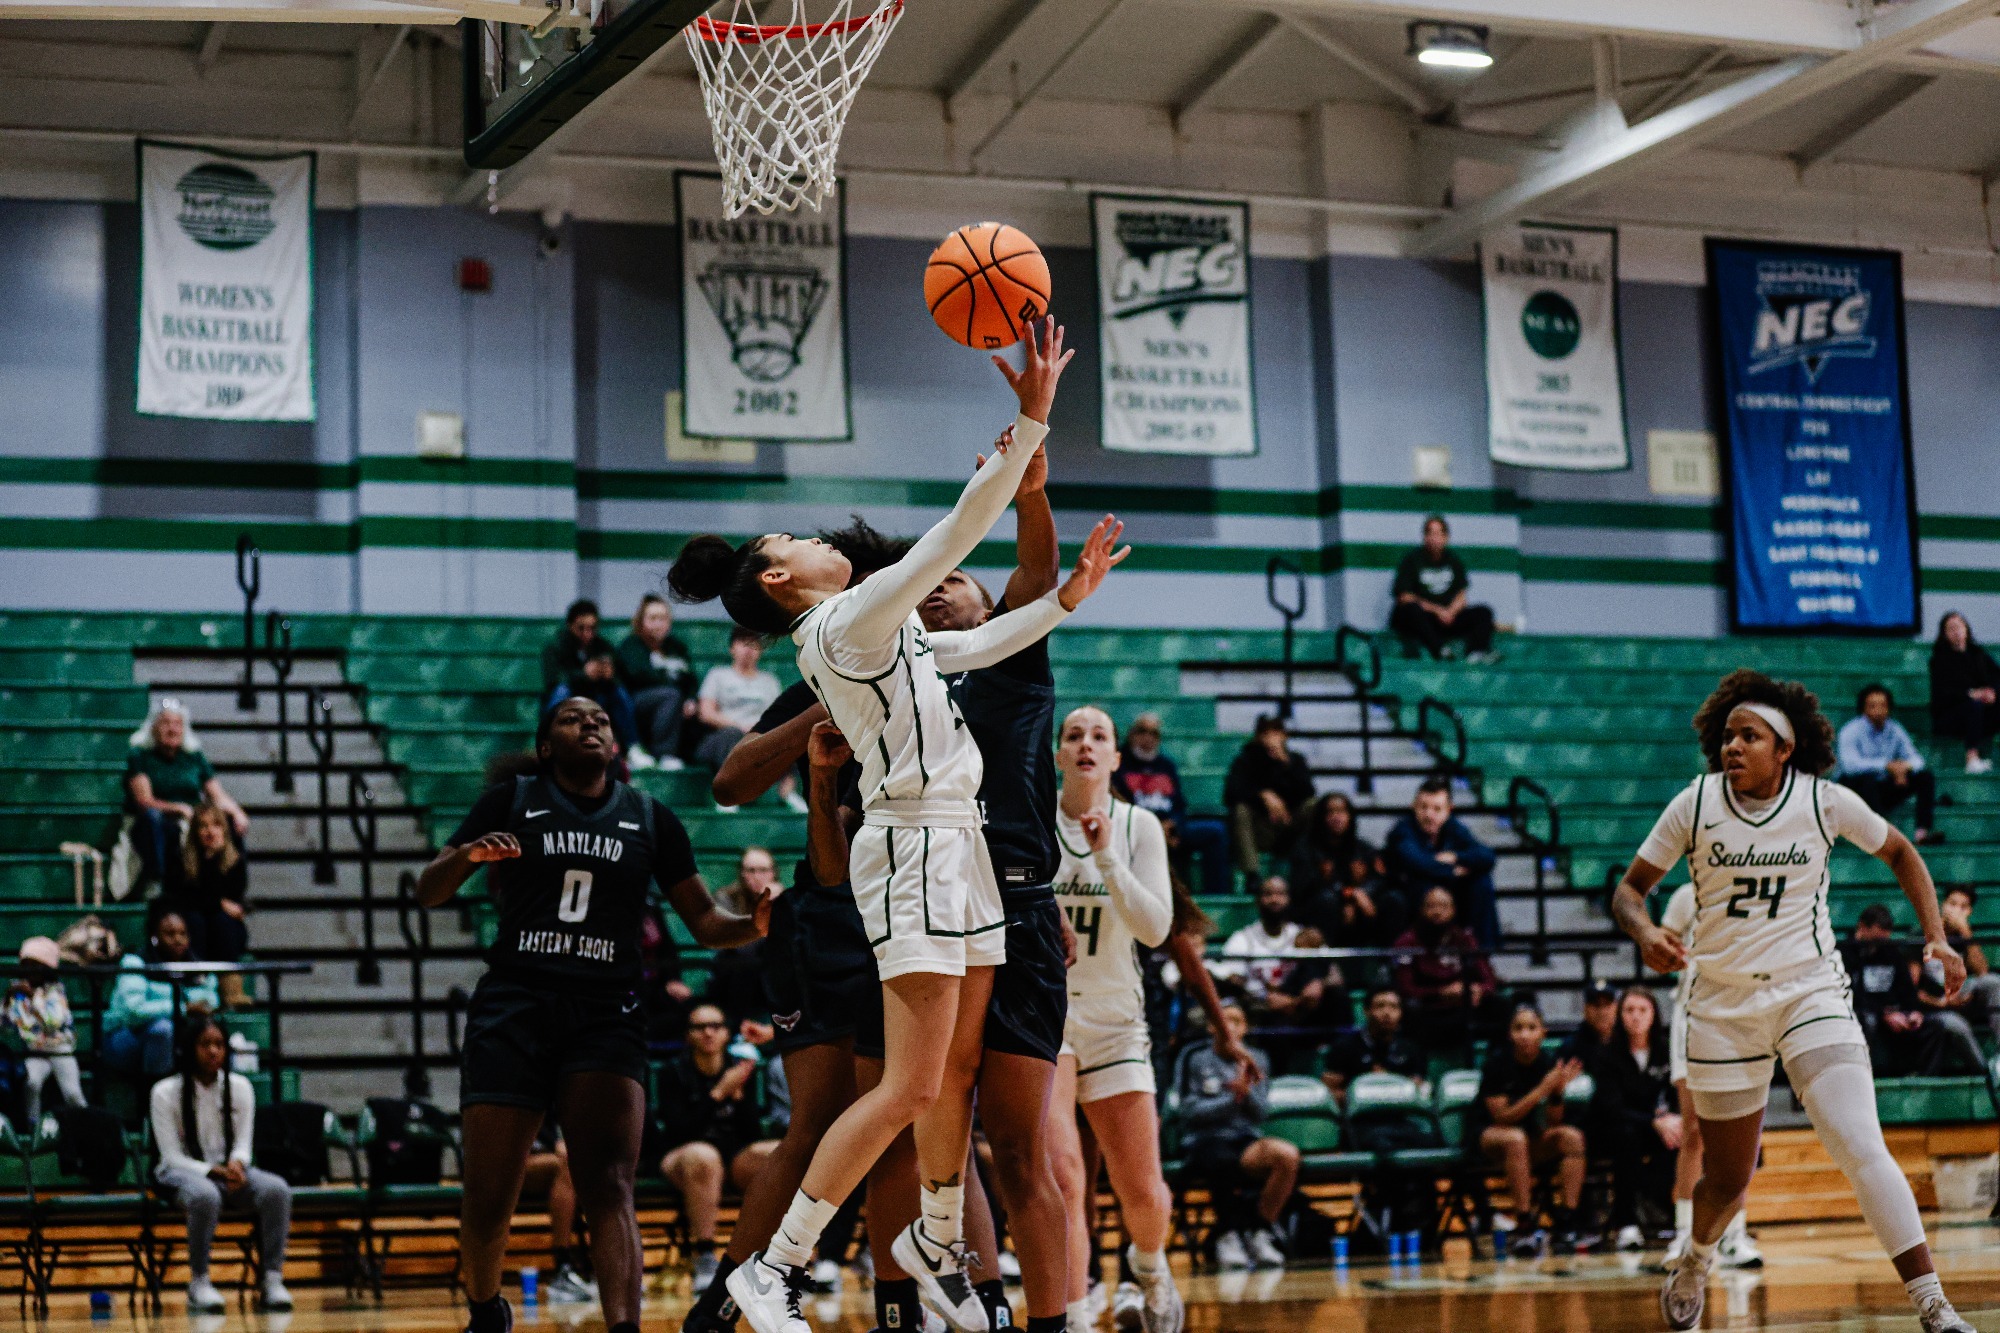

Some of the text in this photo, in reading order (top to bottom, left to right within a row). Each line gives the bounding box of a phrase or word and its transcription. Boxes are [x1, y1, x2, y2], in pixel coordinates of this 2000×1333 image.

[687, 217, 833, 248] BASKETBALL
[1115, 243, 1238, 299] NEC
[177, 283, 275, 311] WOMEN'S
[721, 272, 815, 326] NIT
[161, 314, 288, 344] BASKETBALL
[1755, 292, 1866, 351] NEC
[164, 346, 286, 376] CHAMPIONS
[734, 388, 798, 415] 2002
[542, 831, 624, 863] MARYLAND
[1707, 841, 1811, 868] Seahawks
[558, 869, 593, 923] 0
[1726, 875, 1787, 920] 24
[518, 930, 616, 963] EASTERN SHORE
